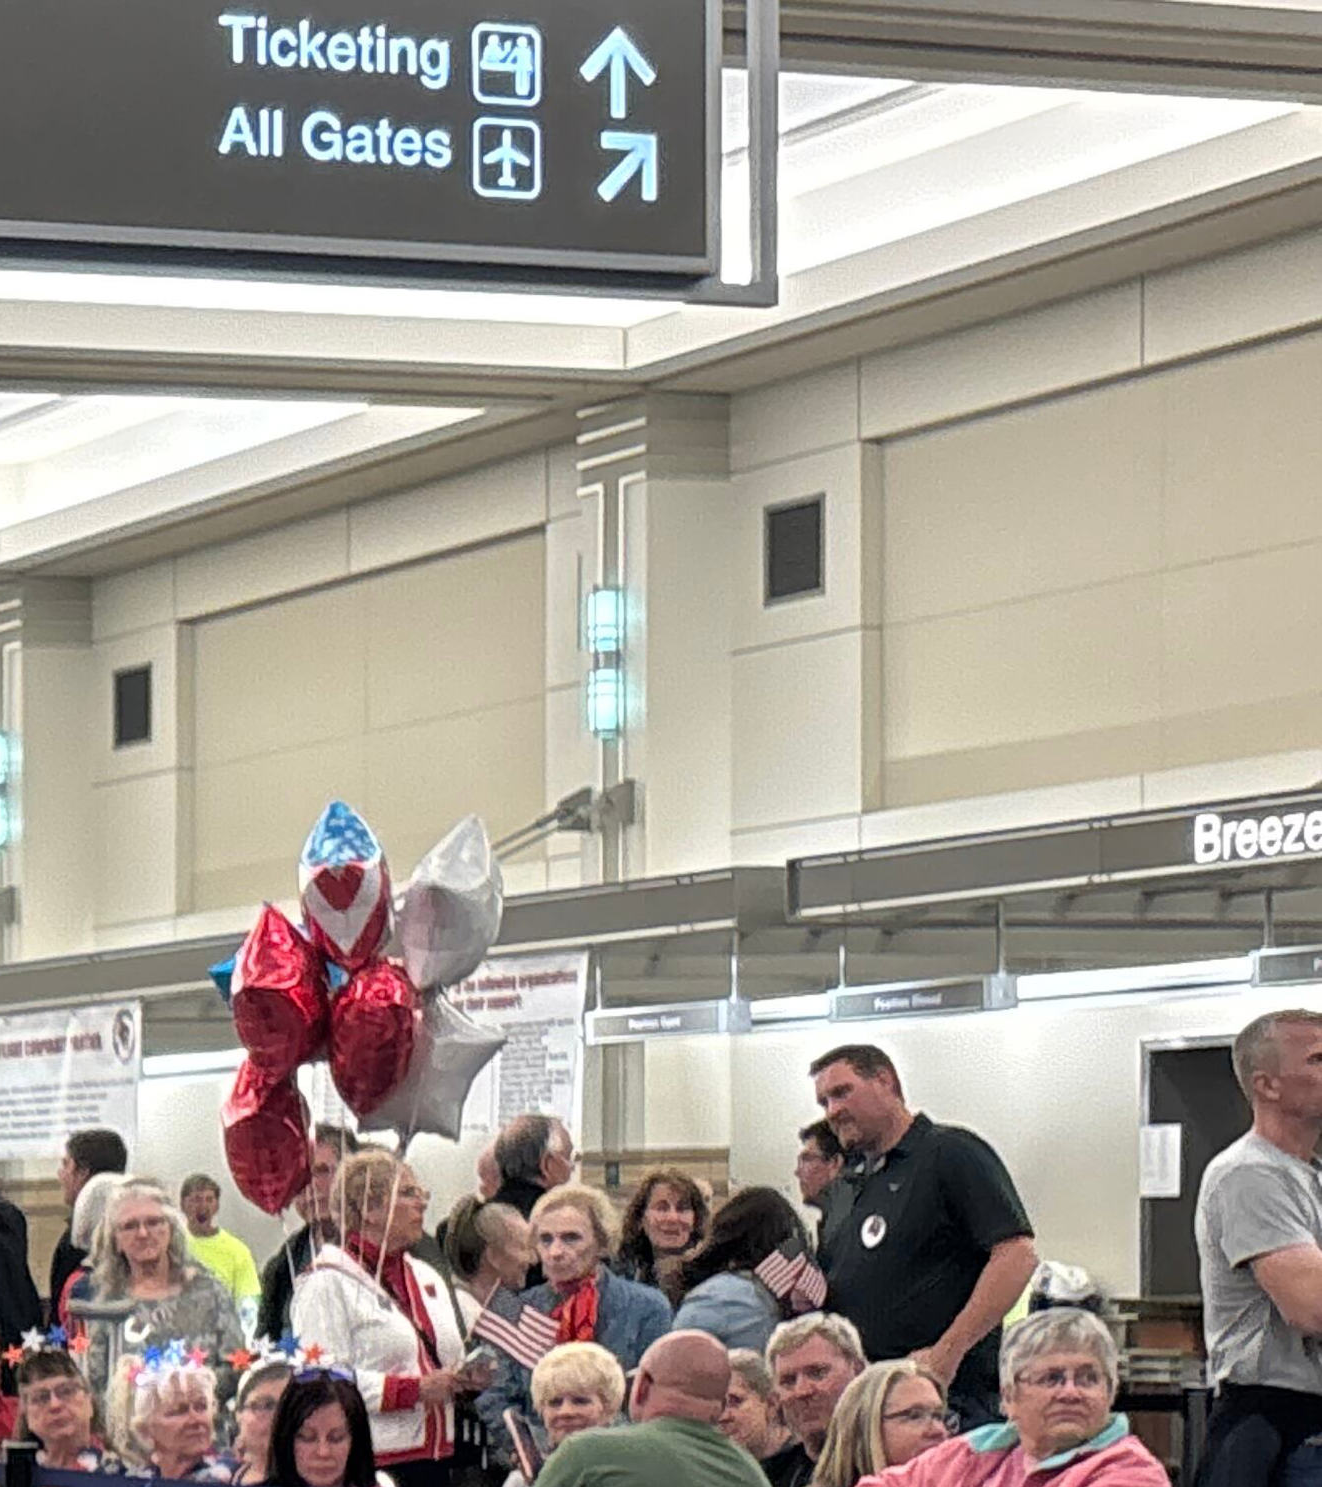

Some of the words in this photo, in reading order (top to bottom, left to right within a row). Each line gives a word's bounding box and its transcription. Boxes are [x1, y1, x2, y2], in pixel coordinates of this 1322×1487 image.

[218, 14, 451, 90] Ticketing
[219, 106, 283, 158] All
[301, 108, 452, 169] Gates
[1194, 811, 1322, 864] Breeze
